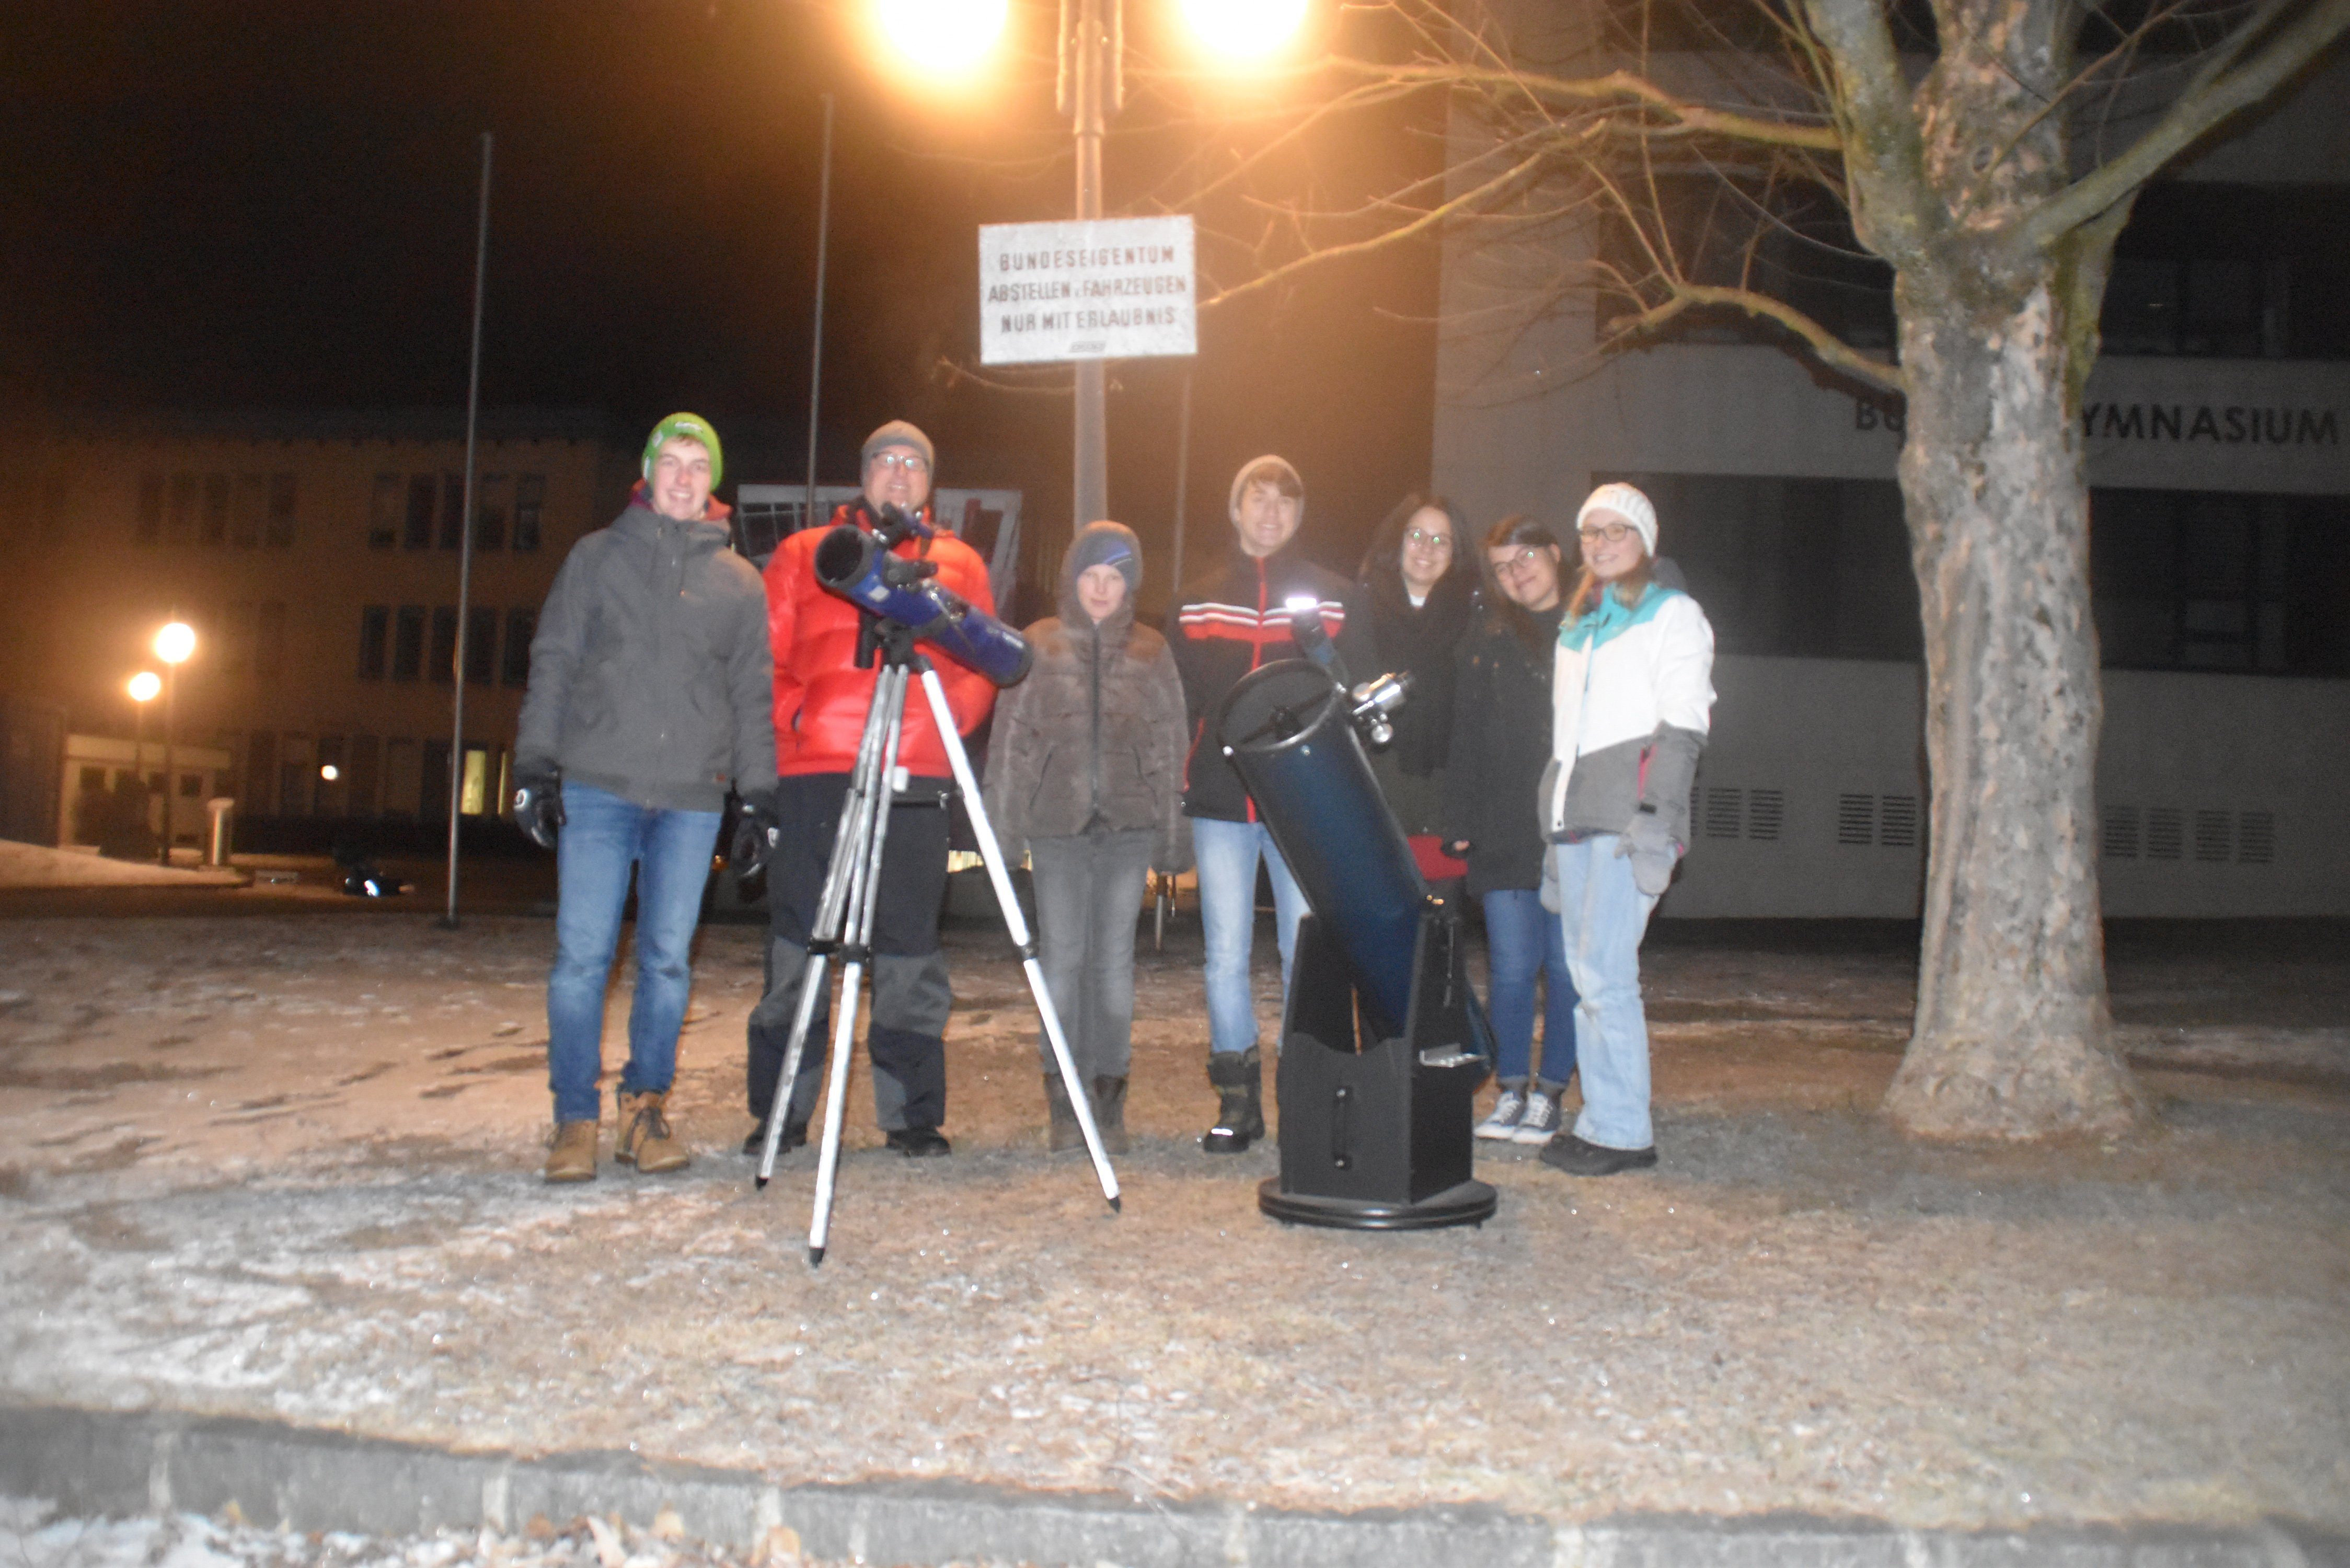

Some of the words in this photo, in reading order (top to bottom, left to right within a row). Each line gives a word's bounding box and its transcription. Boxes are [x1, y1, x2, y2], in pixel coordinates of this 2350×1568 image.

[999, 245, 1174, 271] BUNDESEIGENTUM
[987, 281, 1071, 302] ABSTELLEN
[1082, 275, 1186, 297] FAHRZEUGEN
[1001, 314, 1035, 333] NUR
[1042, 312, 1070, 330] MIT
[1076, 306, 1175, 329] ERLAUBNIS
